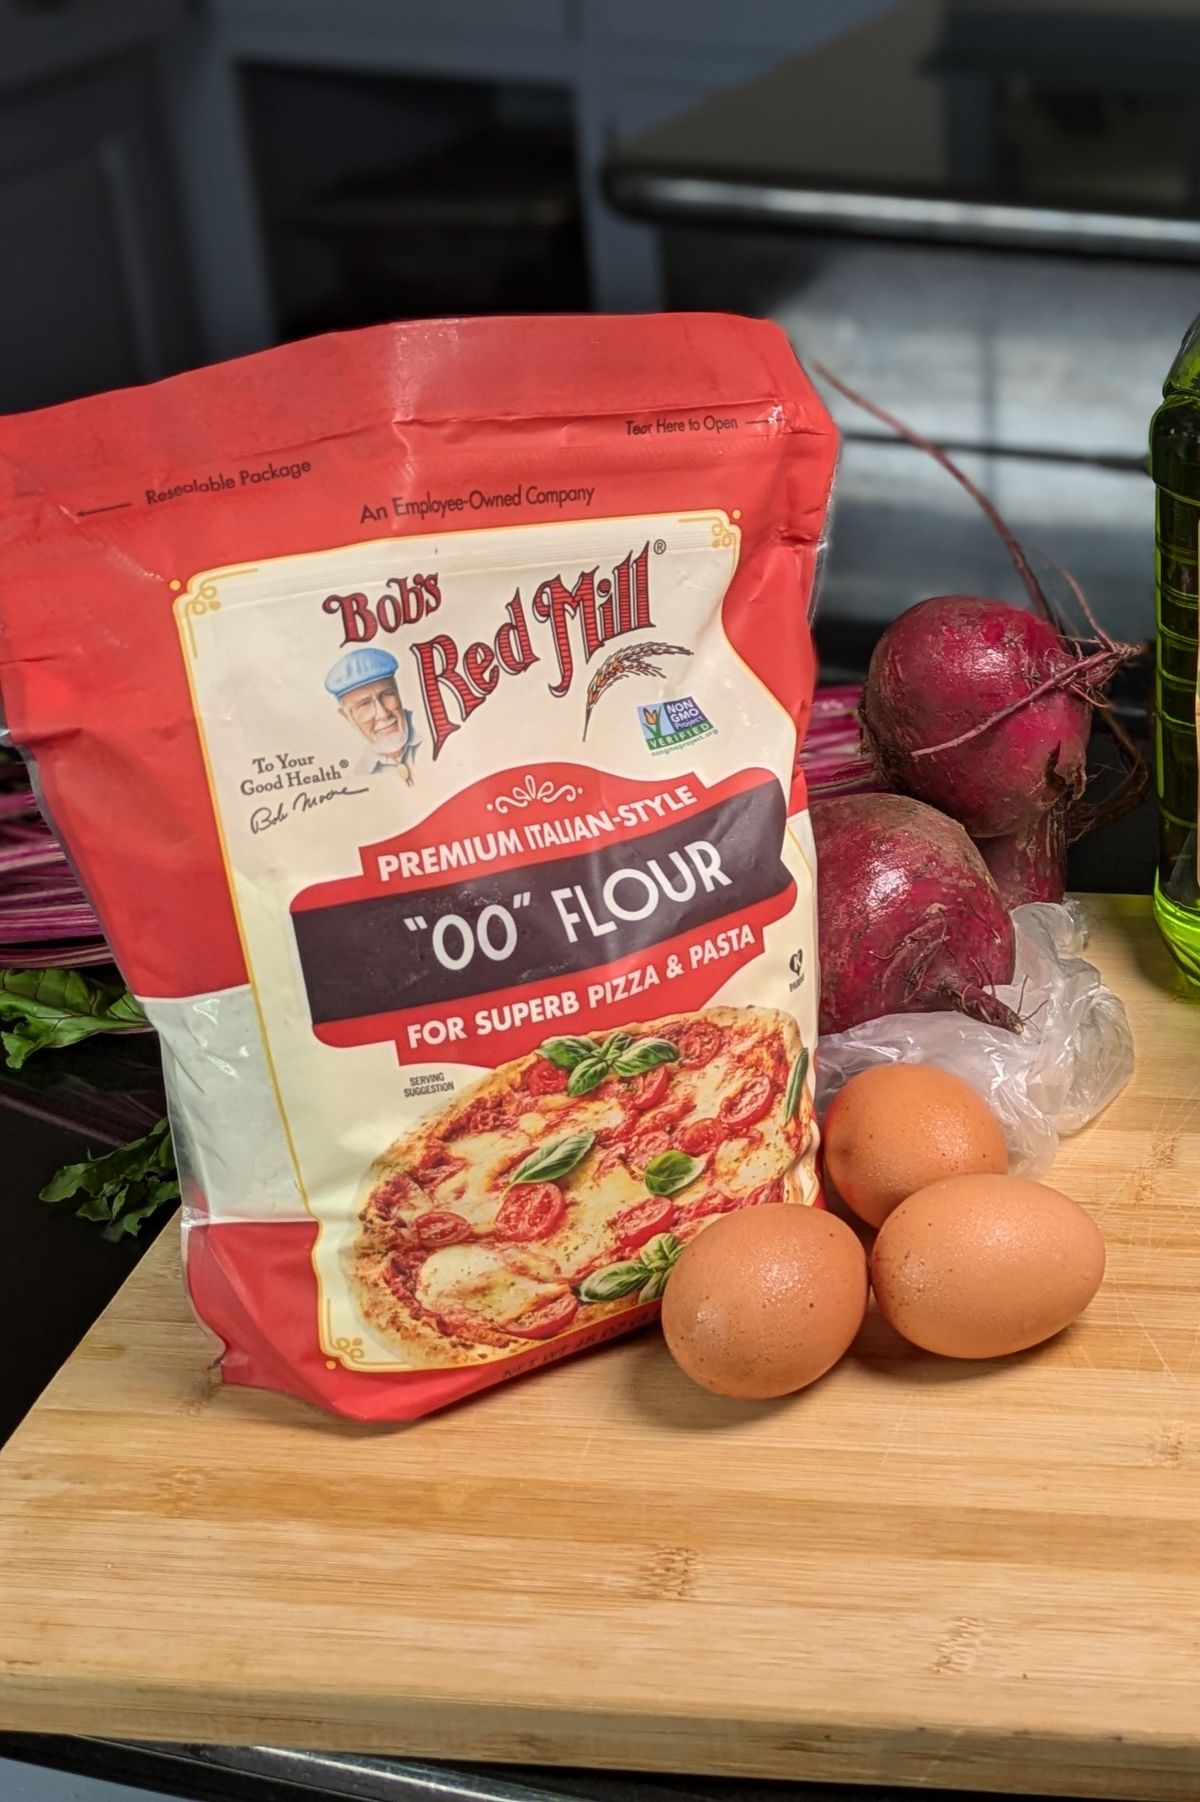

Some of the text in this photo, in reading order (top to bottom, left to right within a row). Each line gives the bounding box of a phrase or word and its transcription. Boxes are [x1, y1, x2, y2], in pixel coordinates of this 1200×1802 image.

[625, 415, 738, 436] Tear Here to Open
[145, 460, 311, 505] Resealable Package
[360, 484, 595, 524] An Employee-Owned Company
[409, 587, 541, 762] Red
[666, 699, 694, 714] NON
[670, 708, 700, 723] GMO
[673, 715, 705, 730] Project
[649, 723, 710, 748] VERIFIED
[252, 753, 315, 774] To Your
[240, 775, 284, 796] Good
[378, 785, 698, 882] PREMIUM ITALIAN-STYLE
[551, 840, 733, 944] FLOUR
[407, 923, 756, 1049] FOR SUPERB PIZZA & PASTA
[403, 1081, 455, 1098] SUGGESTION
[409, 1072, 445, 1086] SERVING
